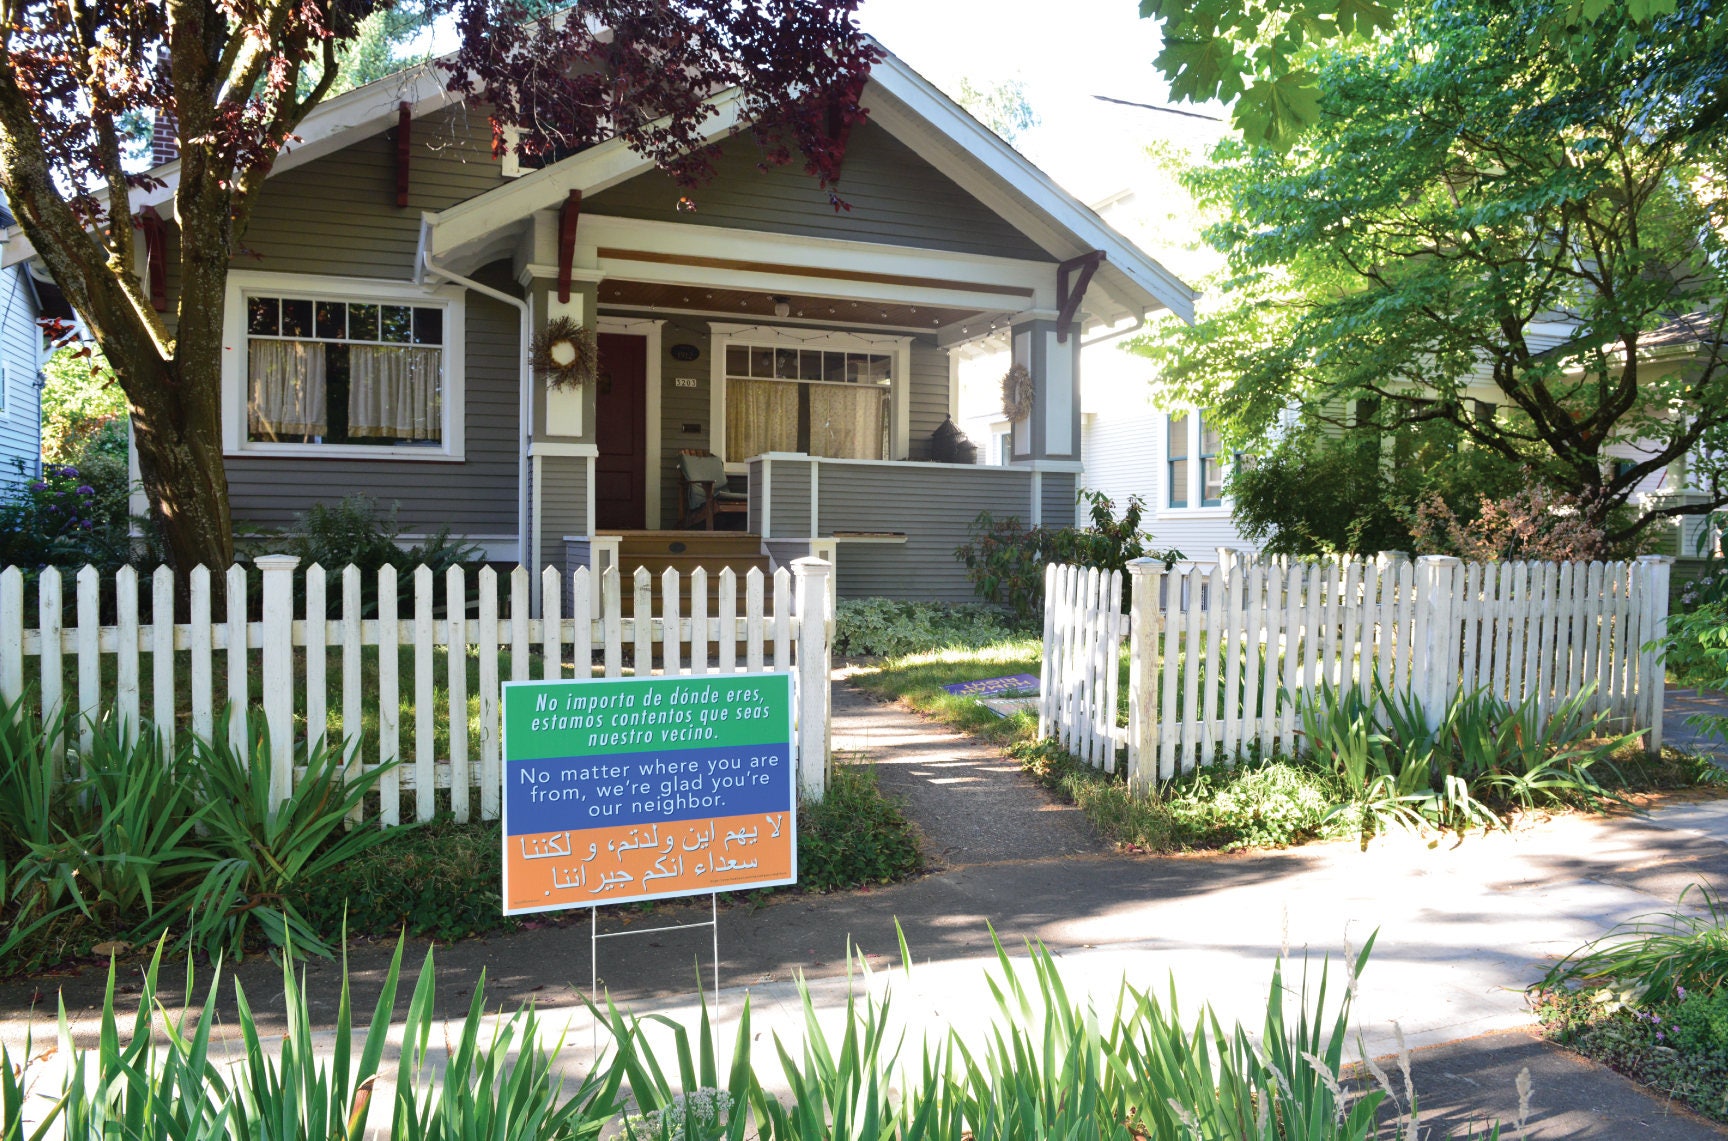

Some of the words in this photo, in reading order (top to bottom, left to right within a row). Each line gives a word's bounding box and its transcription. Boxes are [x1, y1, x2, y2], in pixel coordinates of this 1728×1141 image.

[676, 378, 696, 387] 3203
[536, 694, 557, 711] No
[567, 693, 634, 713] importa
[643, 688, 661, 706] de
[670, 685, 718, 705] dónde
[727, 689, 763, 704] eres,
[532, 714, 602, 730] estamos
[612, 709, 693, 727] contentos
[700, 709, 728, 725] que
[736, 706, 769, 719] seas
[589, 729, 652, 746] nuestro
[662, 724, 717, 741] vecino.
[521, 768, 550, 784] No
[561, 765, 629, 781] matter
[639, 759, 698, 775] where
[708, 759, 740, 775] you
[750, 756, 778, 767] are
[531, 785, 585, 802] from,
[661, 774, 702, 797] glad
[589, 804, 622, 816] our
[632, 793, 725, 815] neighbor.
